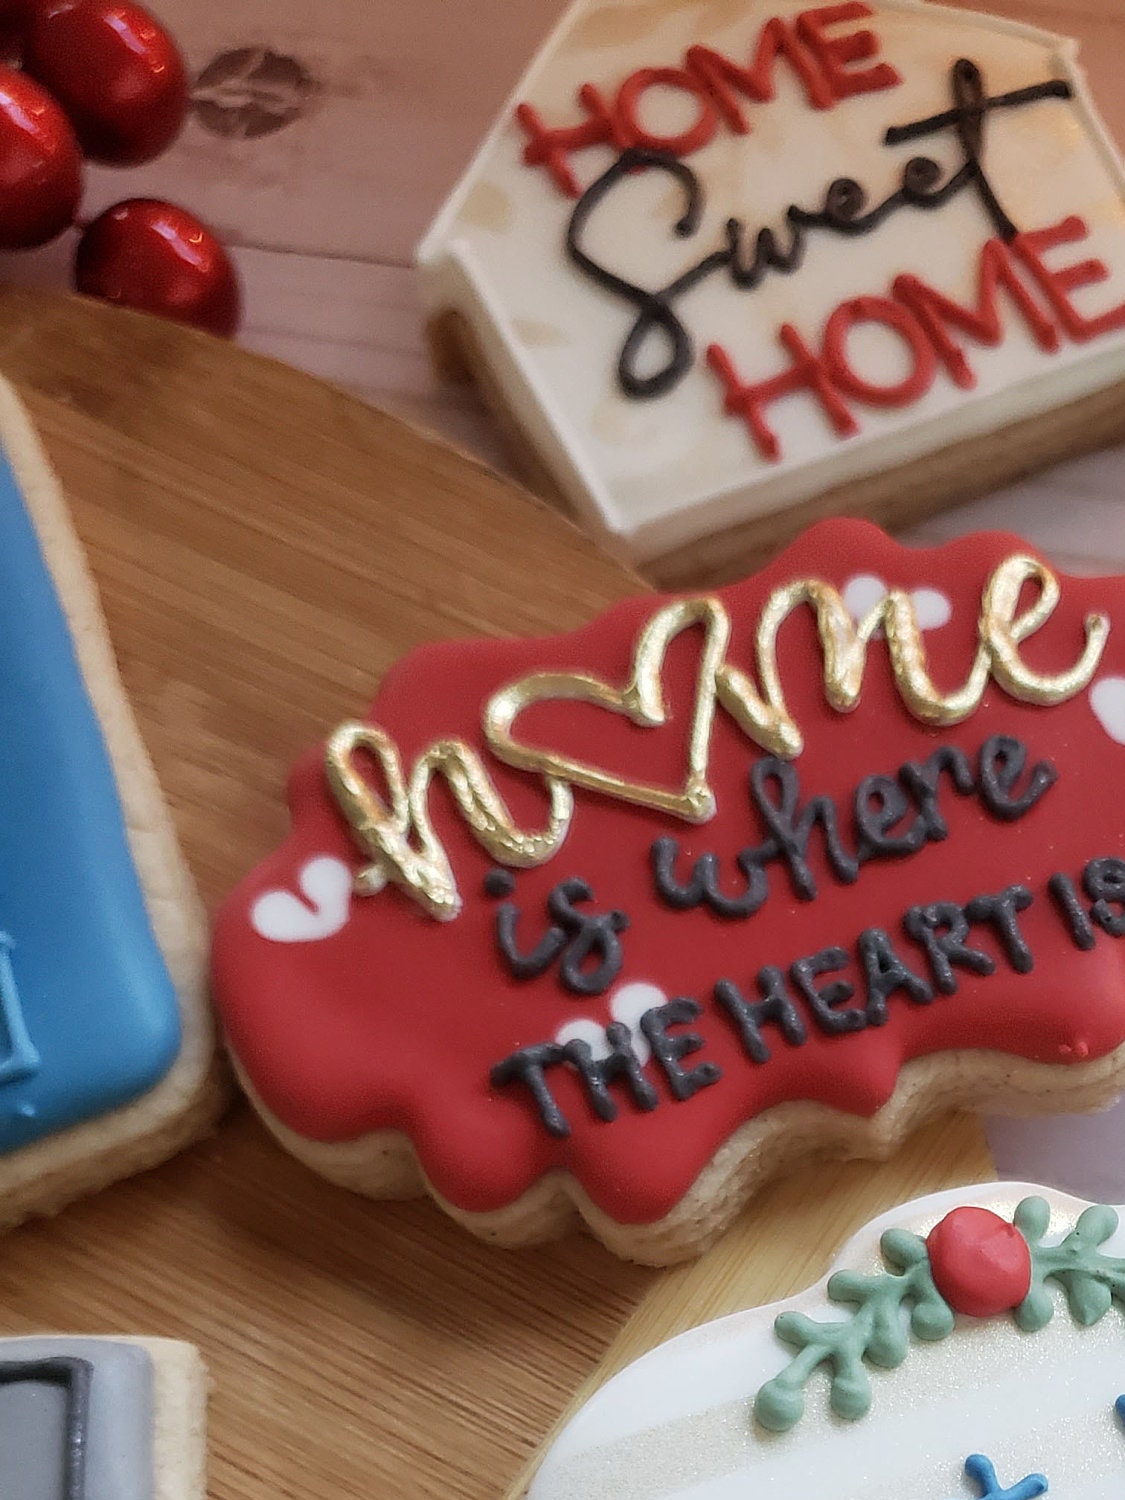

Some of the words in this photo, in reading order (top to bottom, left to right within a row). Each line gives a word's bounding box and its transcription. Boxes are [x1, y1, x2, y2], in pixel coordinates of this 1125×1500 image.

[513, 1, 901, 200] HOME
[566, 58, 1073, 398] Sweet
[484, 868, 629, 996] is
[651, 734, 1060, 920] where
[489, 997, 722, 1138] THE
[712, 883, 1034, 1064] HEART
